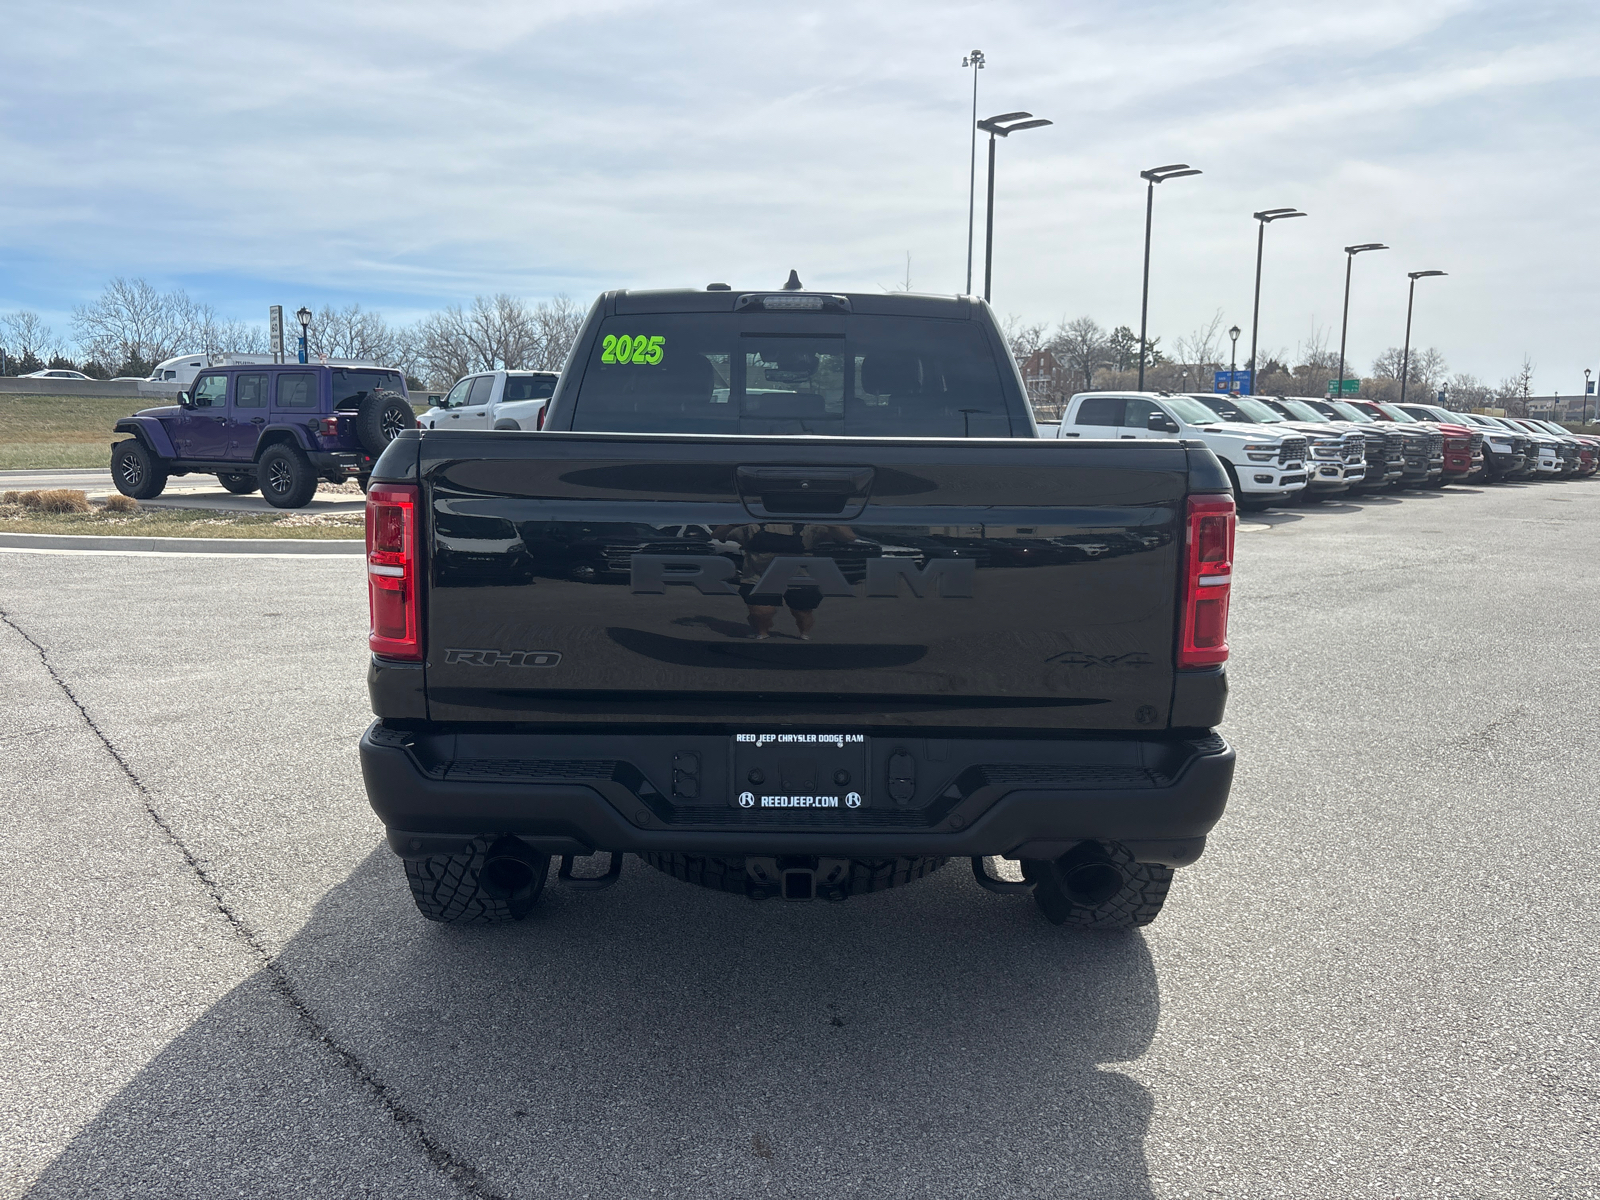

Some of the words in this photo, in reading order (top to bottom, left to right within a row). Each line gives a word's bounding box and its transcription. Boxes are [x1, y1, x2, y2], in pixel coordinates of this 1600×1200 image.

[271, 323, 278, 332] 60
[273, 341, 279, 350] 40
[601, 334, 666, 366] 2025
[630, 554, 976, 598] RAM
[444, 647, 563, 668] RHO
[736, 734, 756, 742] REED
[758, 734, 776, 742] JEEP
[778, 734, 817, 742] CHRYSLER
[818, 734, 844, 742] DODGE
[845, 734, 864, 742] RAM
[761, 796, 838, 807] REEDJEEP.COM
